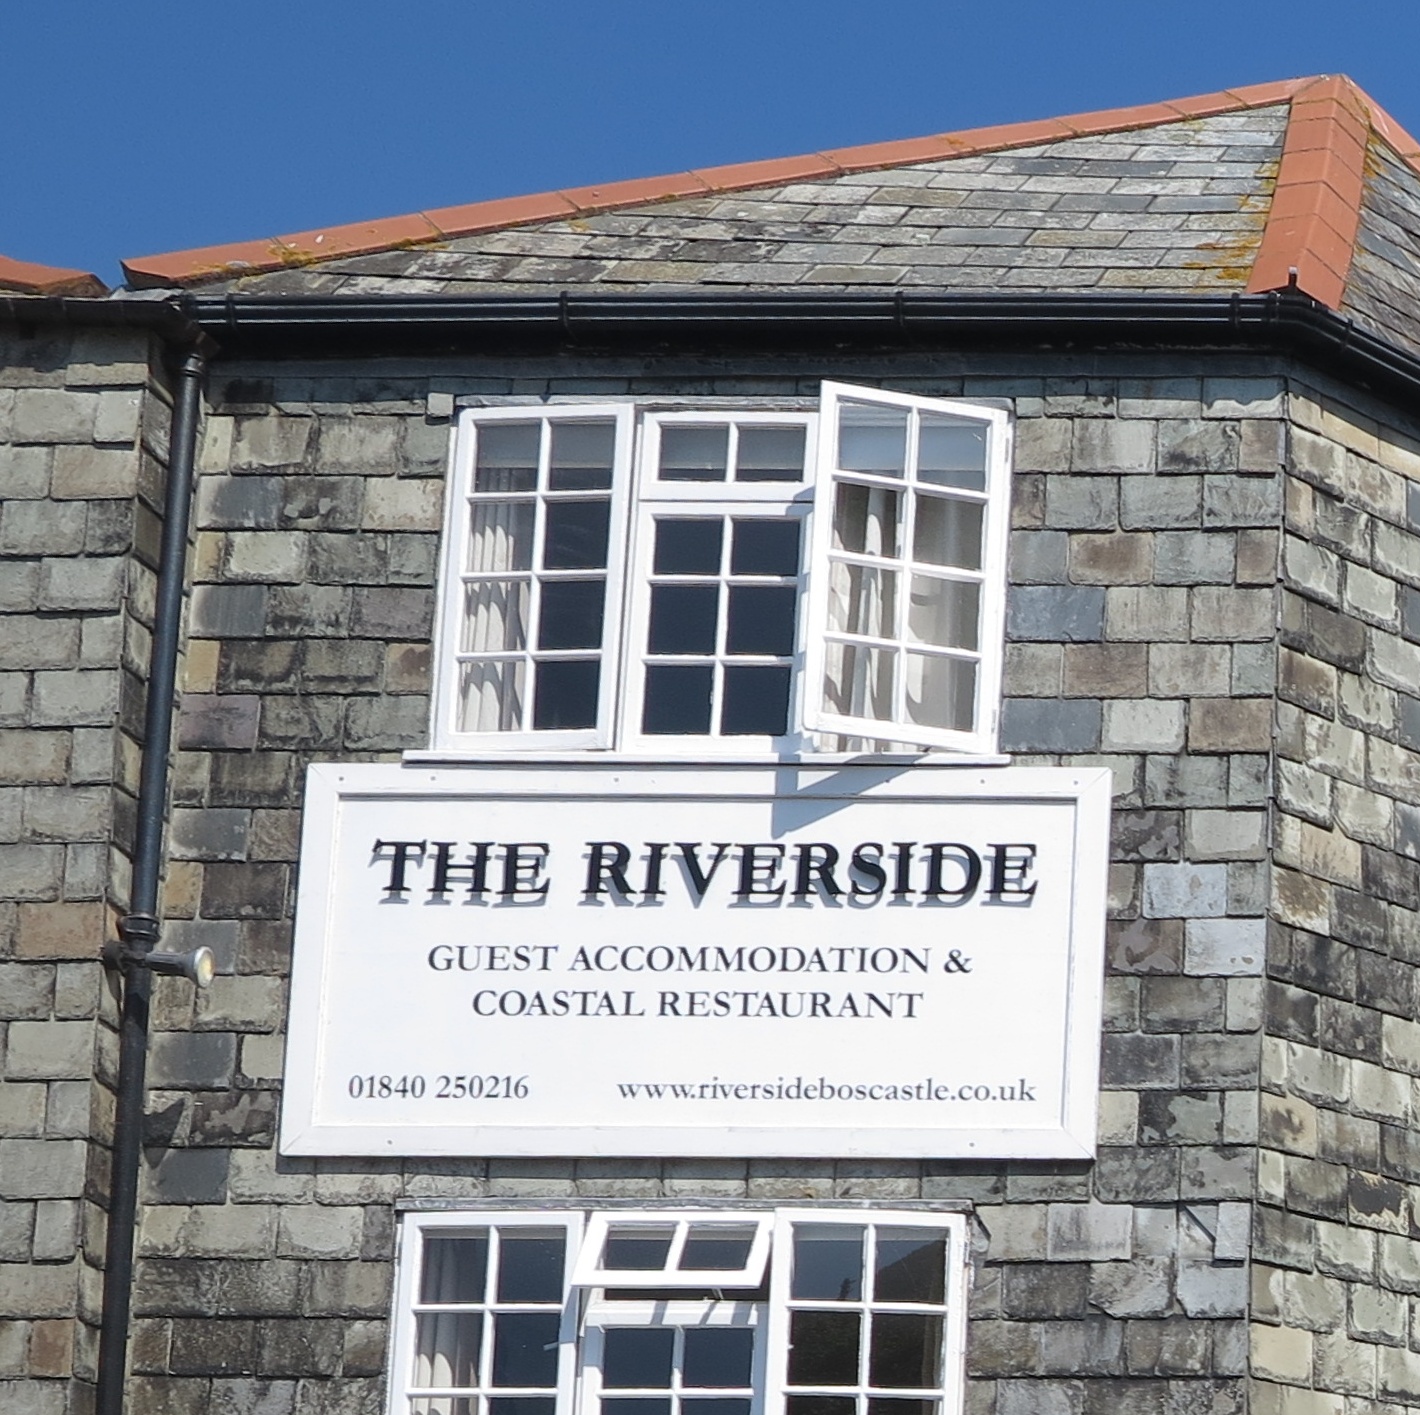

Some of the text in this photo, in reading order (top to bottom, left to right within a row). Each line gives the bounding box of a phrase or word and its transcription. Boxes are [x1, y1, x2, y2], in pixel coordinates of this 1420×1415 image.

[372, 838, 1038, 898] THE RIVERSIDE
[428, 944, 973, 974] GUEST ACCOMMODATION &
[472, 990, 925, 1018] COASTAL RESTAURANT
[348, 1074, 1037, 1101] 01840 250216 www.riversideboscastle.co.uk
